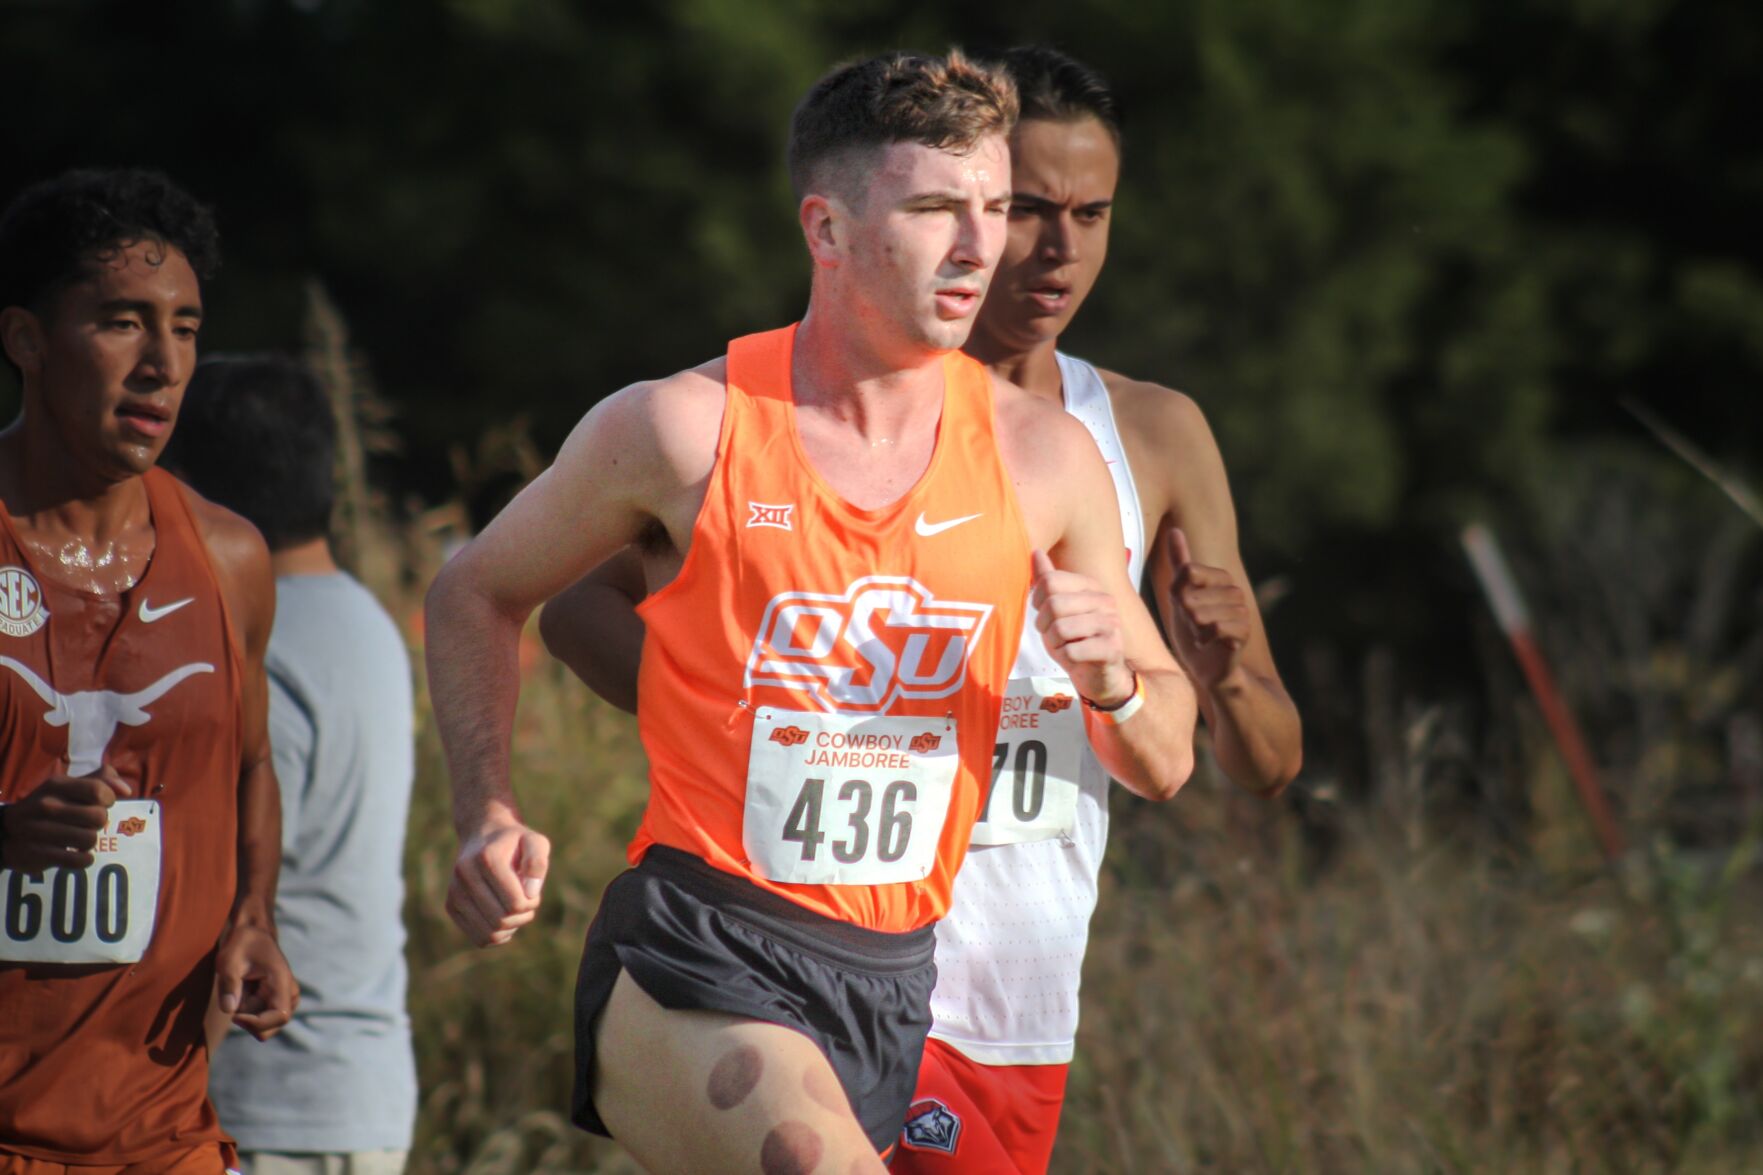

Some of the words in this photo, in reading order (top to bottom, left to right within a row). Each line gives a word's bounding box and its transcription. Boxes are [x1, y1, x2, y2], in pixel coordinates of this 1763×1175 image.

[0, 571, 37, 619] SEC
[745, 576, 993, 715] OSU
[1000, 713, 1040, 730] OREE
[1002, 696, 1034, 712] BOY
[804, 749, 910, 769] JAMBOREE
[816, 731, 903, 750] COWBOY
[975, 740, 1048, 823] 70
[782, 778, 918, 864] 436
[5, 863, 129, 943] 600
